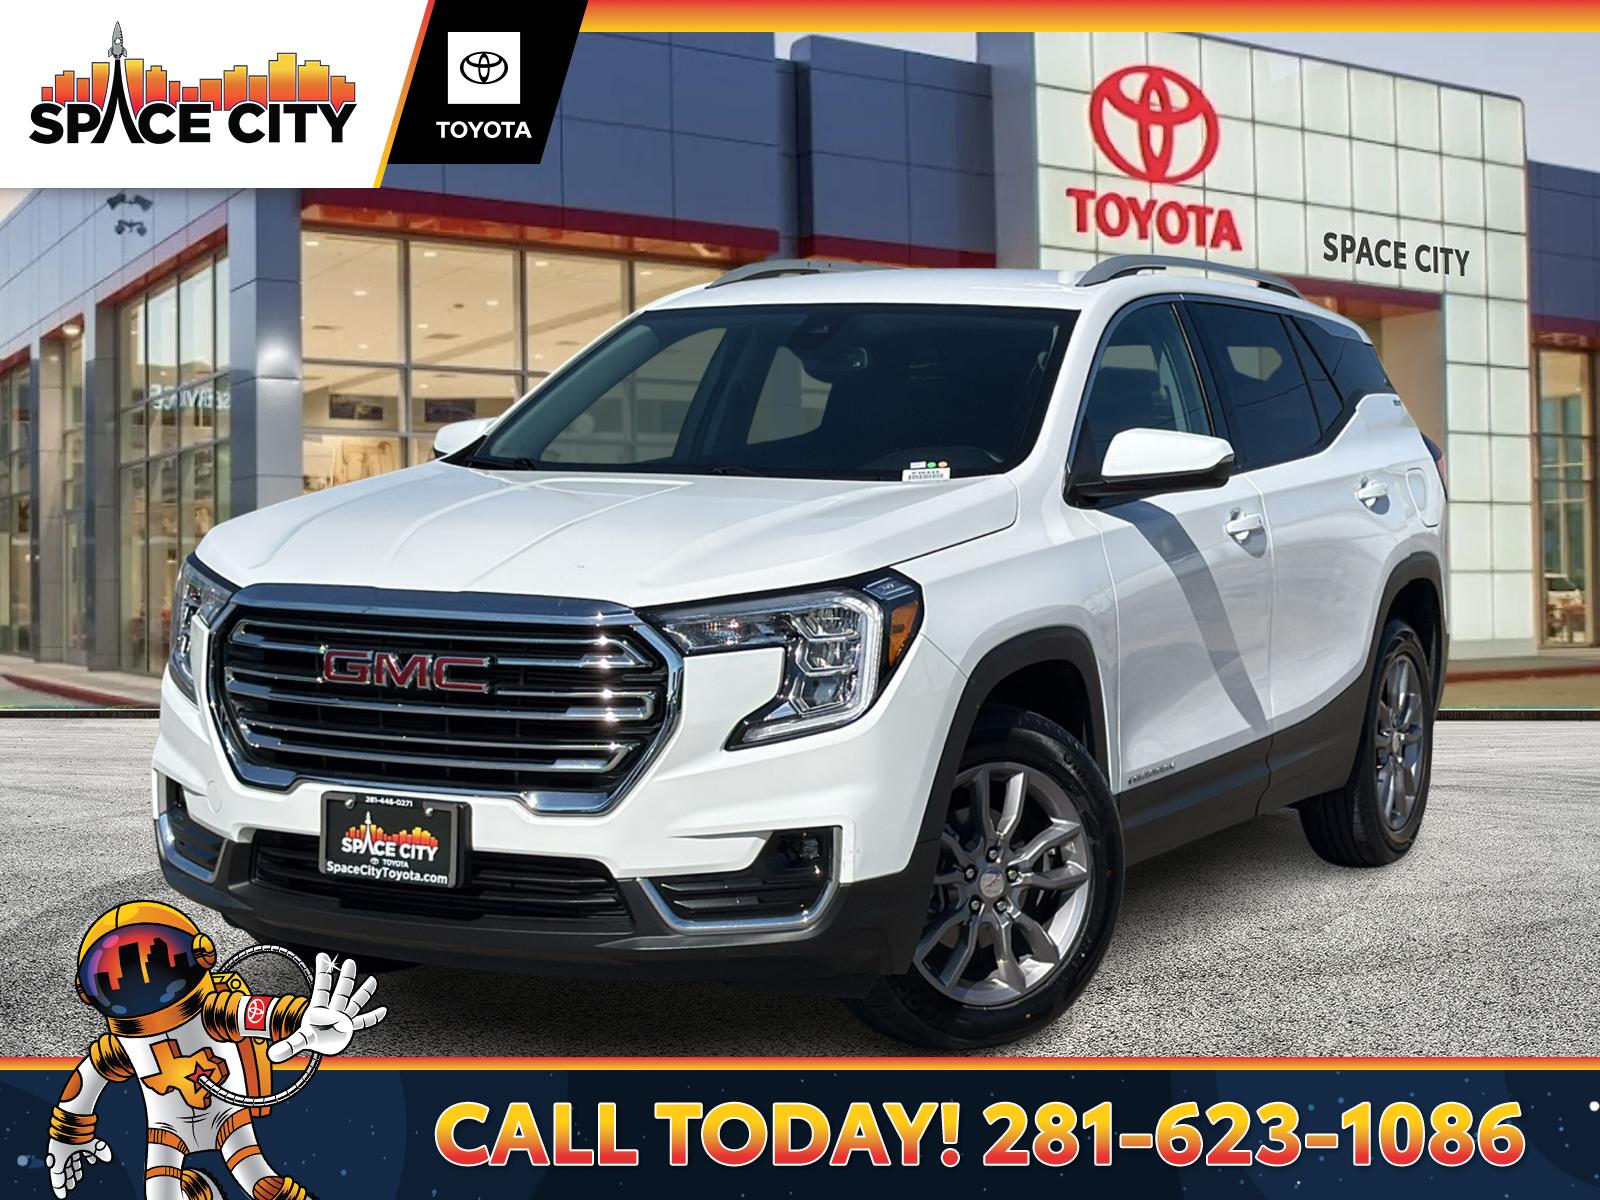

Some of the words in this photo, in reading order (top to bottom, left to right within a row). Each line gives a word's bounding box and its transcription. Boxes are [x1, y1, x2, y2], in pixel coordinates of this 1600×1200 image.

[1066, 188, 1242, 251] TOYOTA
[1323, 232, 1407, 270] SPACE
[1414, 244, 1470, 277] CITY
[323, 649, 491, 694] GMC
[341, 837, 396, 857] SPACE
[399, 843, 438, 861] CITY
[382, 858, 409, 868] TOYOTA
[326, 860, 448, 884] SpaceCityToyota.com
